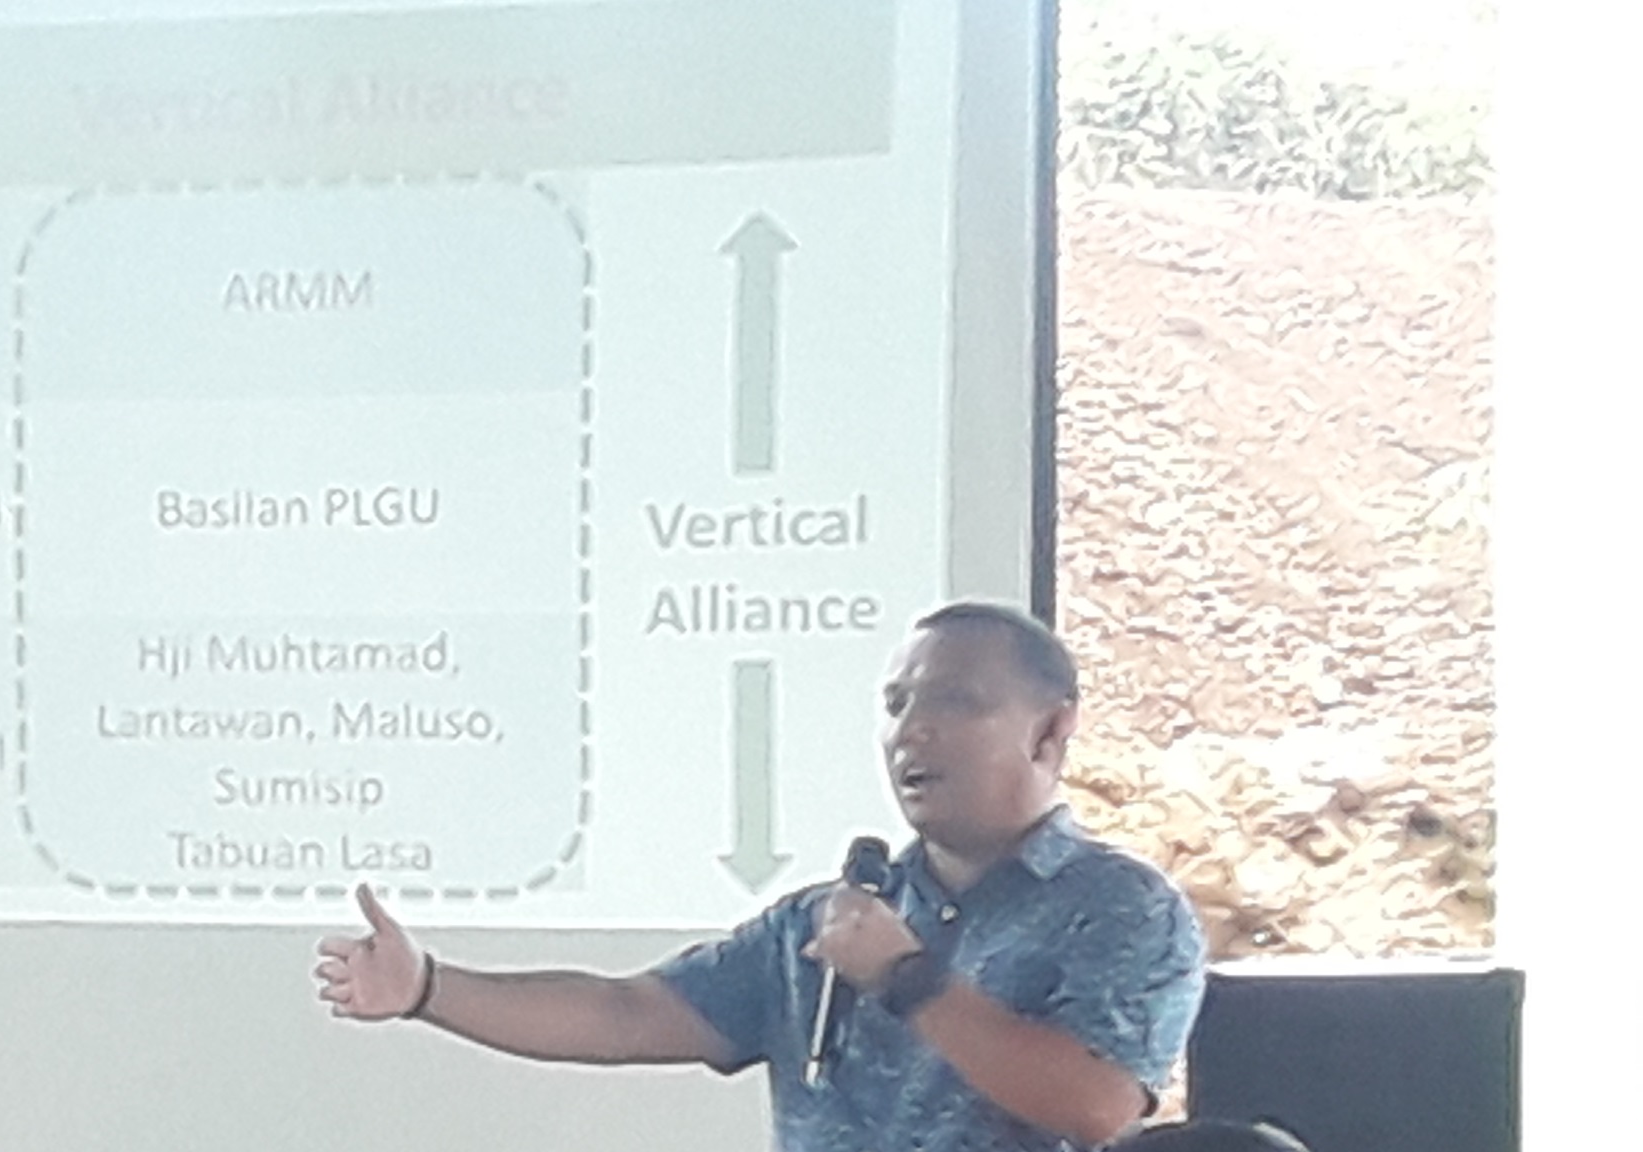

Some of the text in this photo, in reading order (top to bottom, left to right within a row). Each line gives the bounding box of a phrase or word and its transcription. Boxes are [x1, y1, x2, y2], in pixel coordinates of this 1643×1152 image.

[321, 69, 570, 127] Alliance
[224, 270, 374, 311] ARMM
[157, 486, 440, 529] Basilan PLGU
[644, 493, 868, 550] Vertical
[644, 582, 882, 635] Alliance
[138, 630, 460, 680] Hji Muhtamad,
[97, 701, 505, 744] Lantawan, Maluso,
[213, 767, 384, 813] Sumisip
[166, 830, 433, 871] Tabuan Lasa
